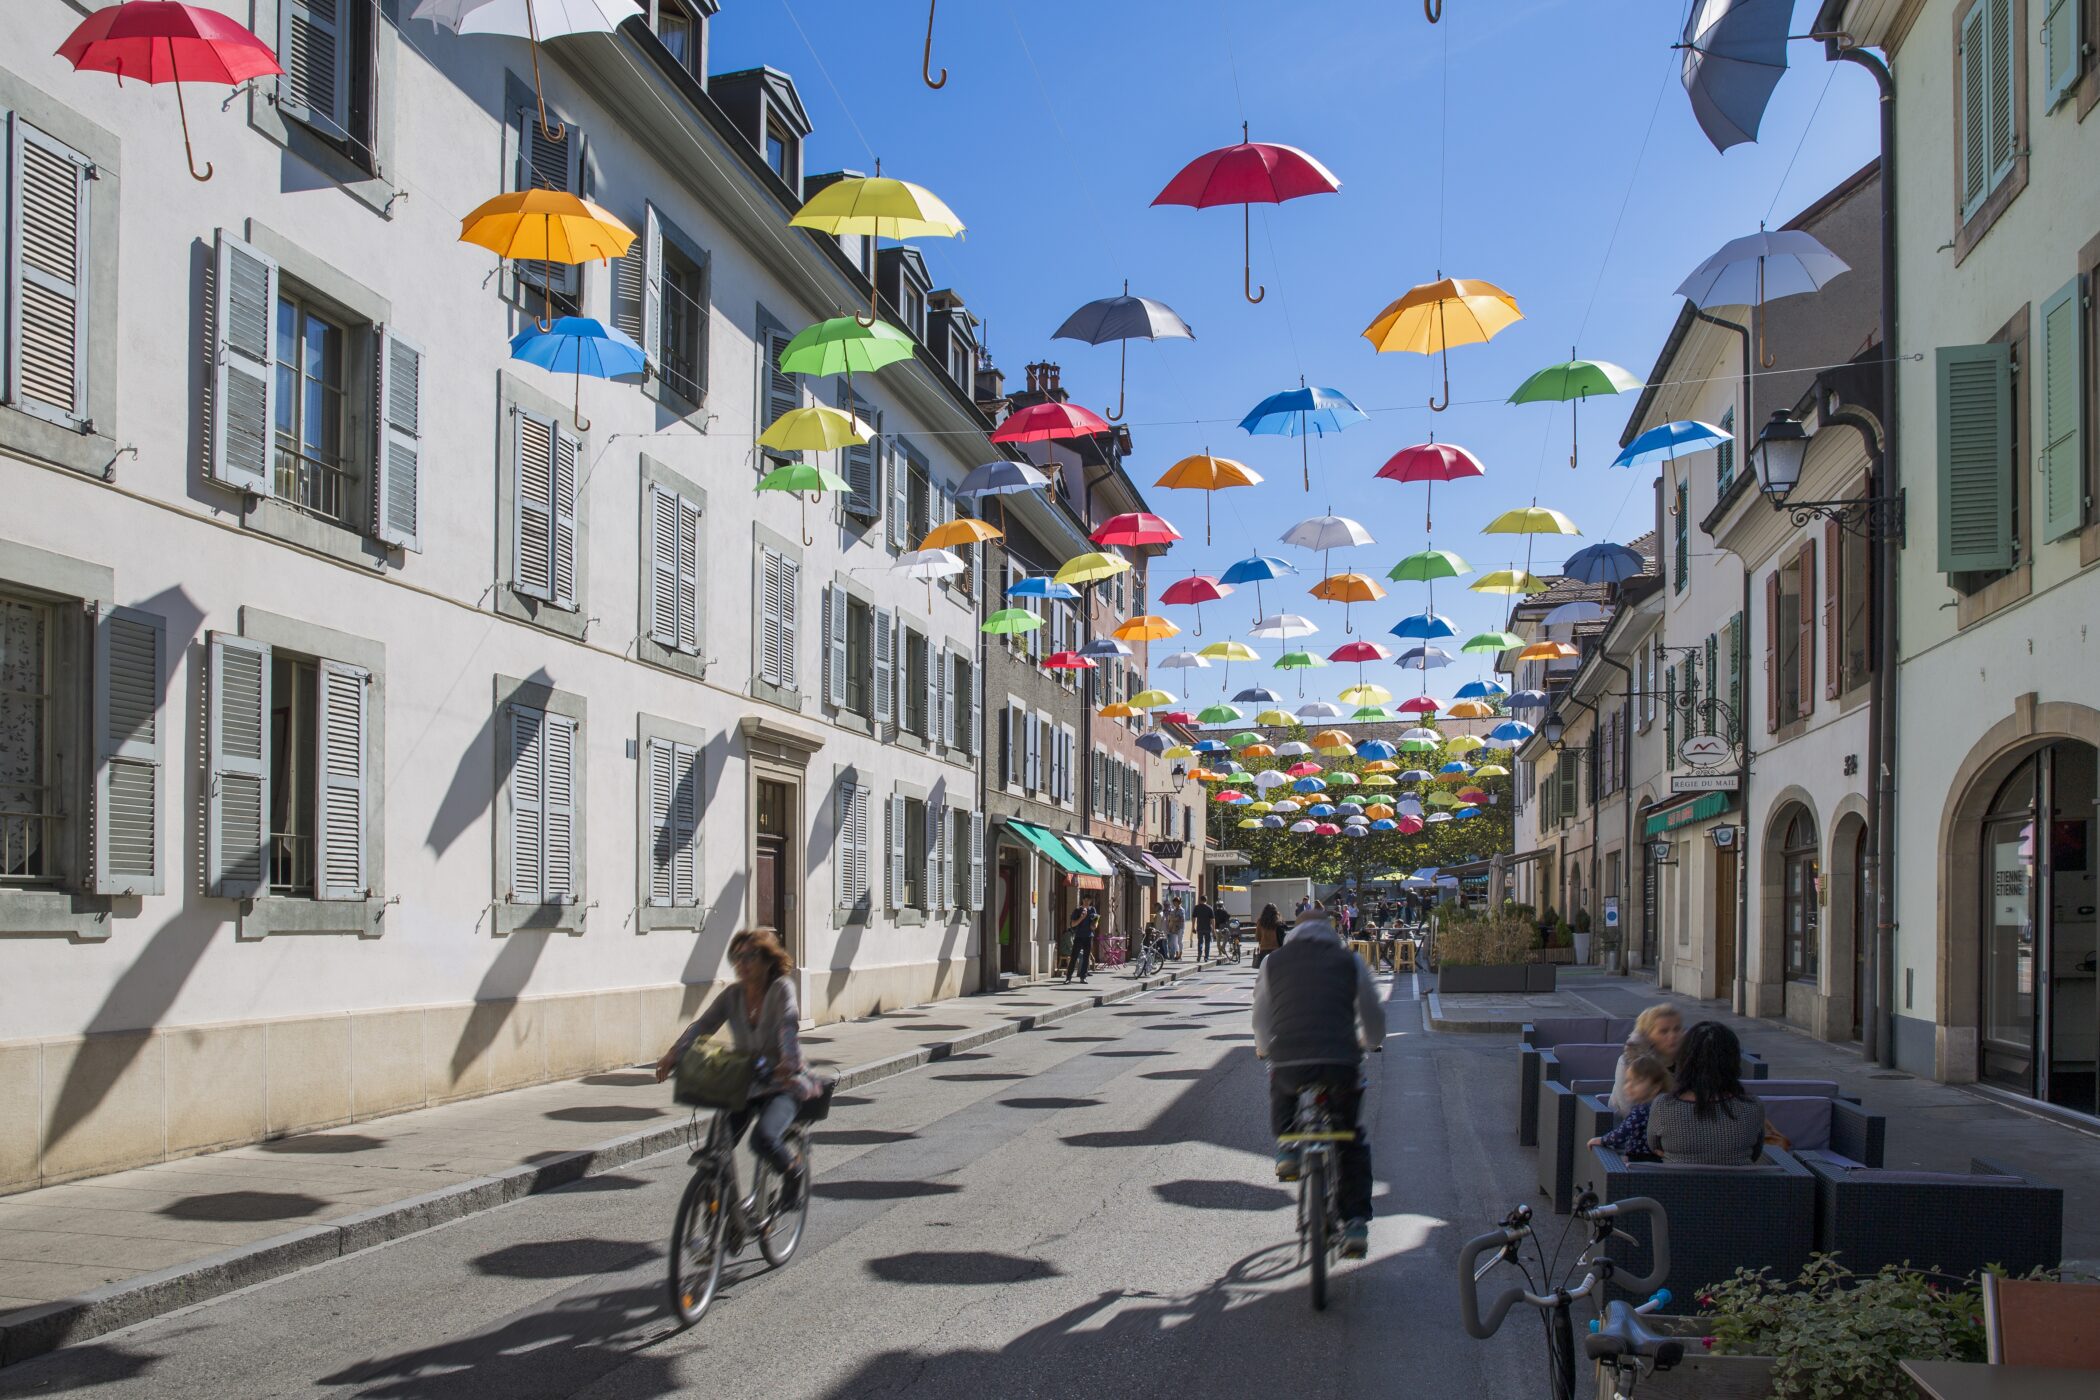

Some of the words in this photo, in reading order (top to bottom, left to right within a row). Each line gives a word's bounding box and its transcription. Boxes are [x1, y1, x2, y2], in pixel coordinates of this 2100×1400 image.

[1674, 780, 1698, 788] RÉGIE
[1715, 779, 1736, 787] MAIL
[759, 813, 768, 826] 41
[1996, 870, 2024, 883] ETIENNE
[1996, 884, 2025, 896] ETIENNE
